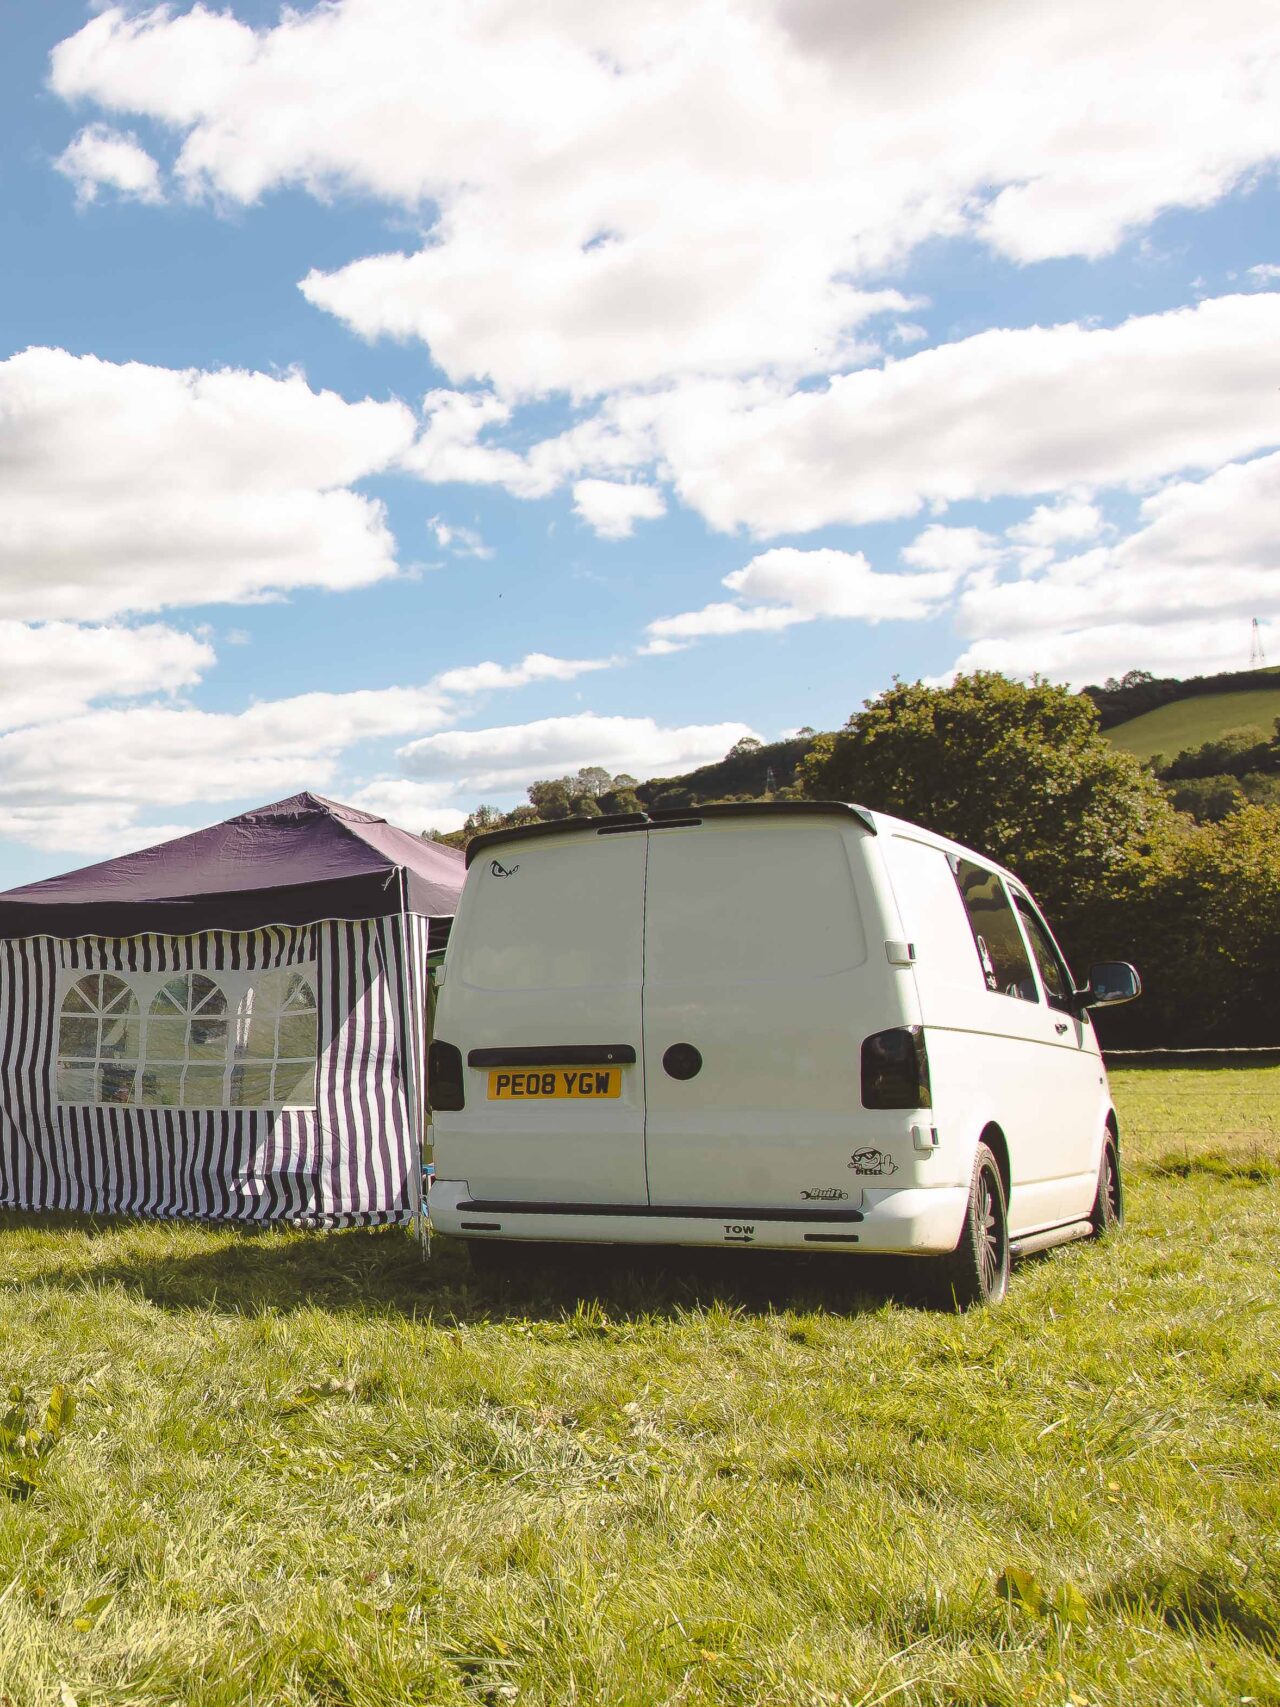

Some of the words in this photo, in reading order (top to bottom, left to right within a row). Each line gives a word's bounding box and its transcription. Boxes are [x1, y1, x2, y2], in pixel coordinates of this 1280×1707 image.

[496, 1073, 556, 1096] PE08
[563, 1072, 610, 1095] YGW
[810, 1187, 842, 1198] Built
[723, 1225, 755, 1234] TOW
